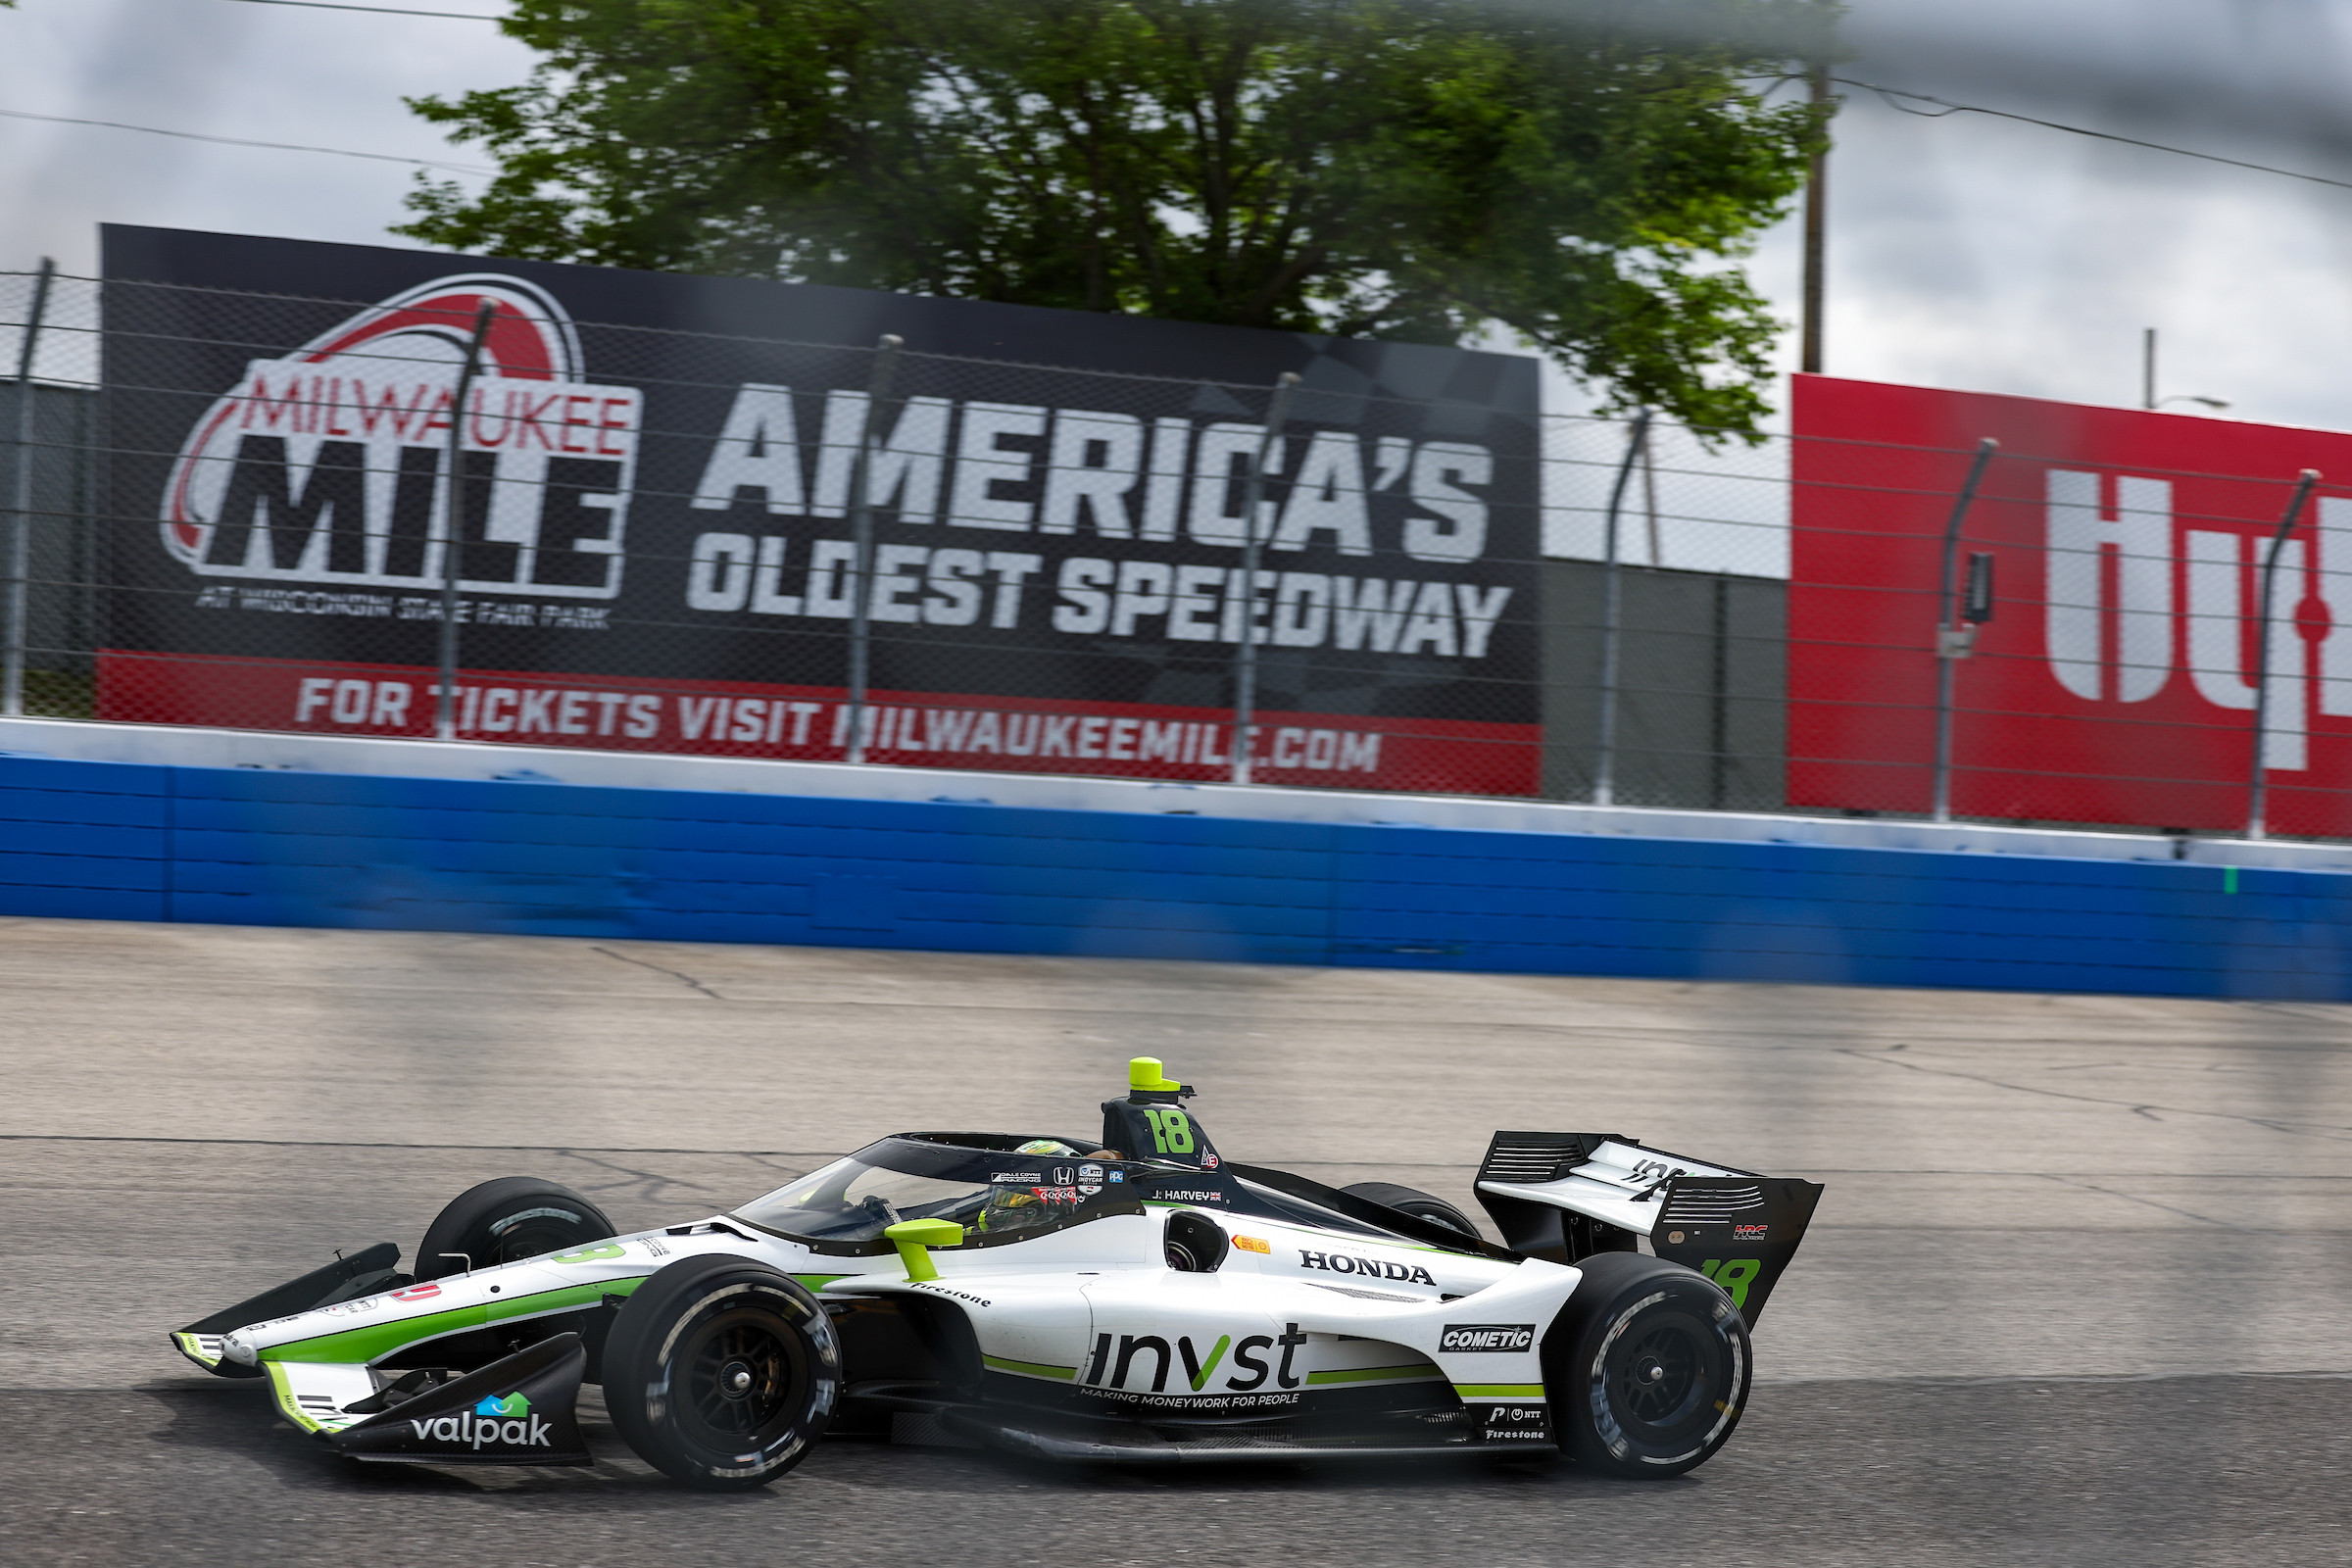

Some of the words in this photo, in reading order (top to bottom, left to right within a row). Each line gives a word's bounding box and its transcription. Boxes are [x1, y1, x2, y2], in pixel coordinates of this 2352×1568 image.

[241, 375, 633, 456] MILWAUKEE
[690, 382, 1494, 564] AMERICA'S
[200, 434, 624, 590] MILE
[196, 586, 237, 609] AT
[397, 597, 472, 622] STAE
[476, 602, 536, 626] FAIR
[540, 605, 612, 629] PARK
[686, 531, 1044, 630] OLDEST
[1052, 557, 1514, 659] SPEEDWAY
[2045, 468, 2352, 771] Hy
[295, 677, 413, 727] FOR
[678, 697, 822, 746] VISIT
[1144, 1109, 1195, 1153] 18
[1109, 1171, 1124, 1182] PPG
[1165, 1190, 1210, 1200] HARVEY
[1298, 1250, 1437, 1287] HONDA
[909, 1282, 992, 1307] Firestone
[1086, 1323, 1307, 1393] invst
[1444, 1331, 1532, 1348] COMETIC
[1080, 1388, 1139, 1403] MAKING
[1231, 1396, 1255, 1407] FOR
[1257, 1394, 1300, 1405] PEOPLE
[410, 1411, 554, 1450] valpak
[1485, 1430, 1545, 1440] Firestone
